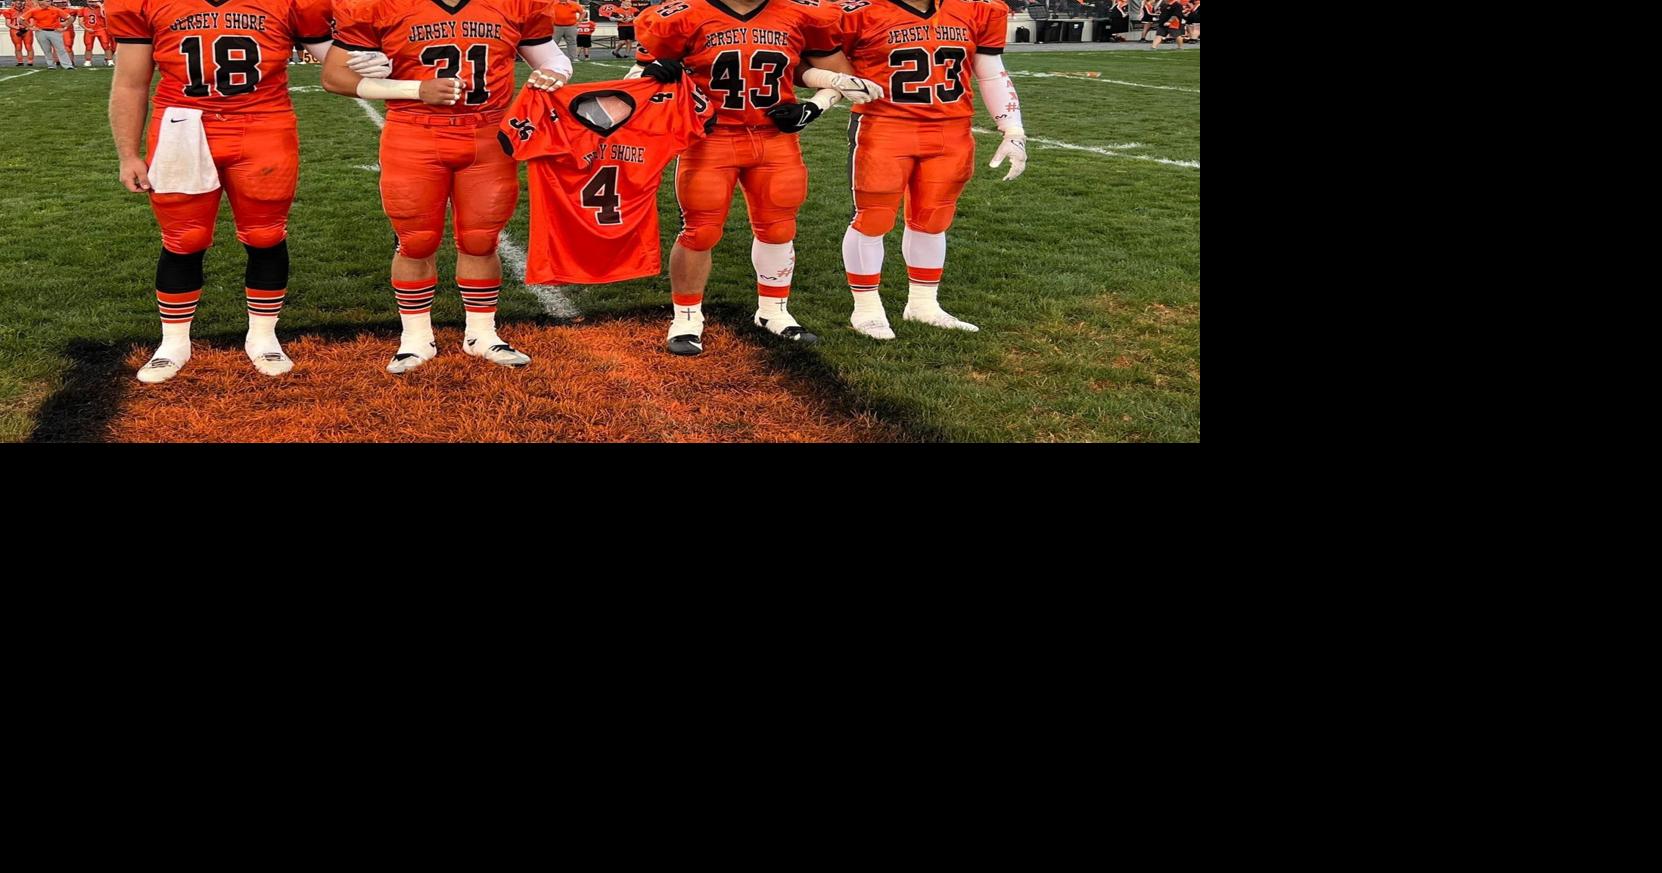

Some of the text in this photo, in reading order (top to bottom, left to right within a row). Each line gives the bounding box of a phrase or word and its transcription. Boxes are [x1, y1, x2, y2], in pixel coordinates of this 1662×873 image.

[169, 12, 266, 31] JERSEY SHORE
[408, 21, 502, 42] JERSEY SHORE
[704, 28, 789, 48] JERSEY SHORE
[887, 25, 969, 44] JERSEY SHORE
[179, 34, 262, 98] 18
[888, 45, 968, 105] 23
[709, 49, 791, 111] 43
[610, 143, 646, 165] SHORE
[580, 165, 624, 226] 4
